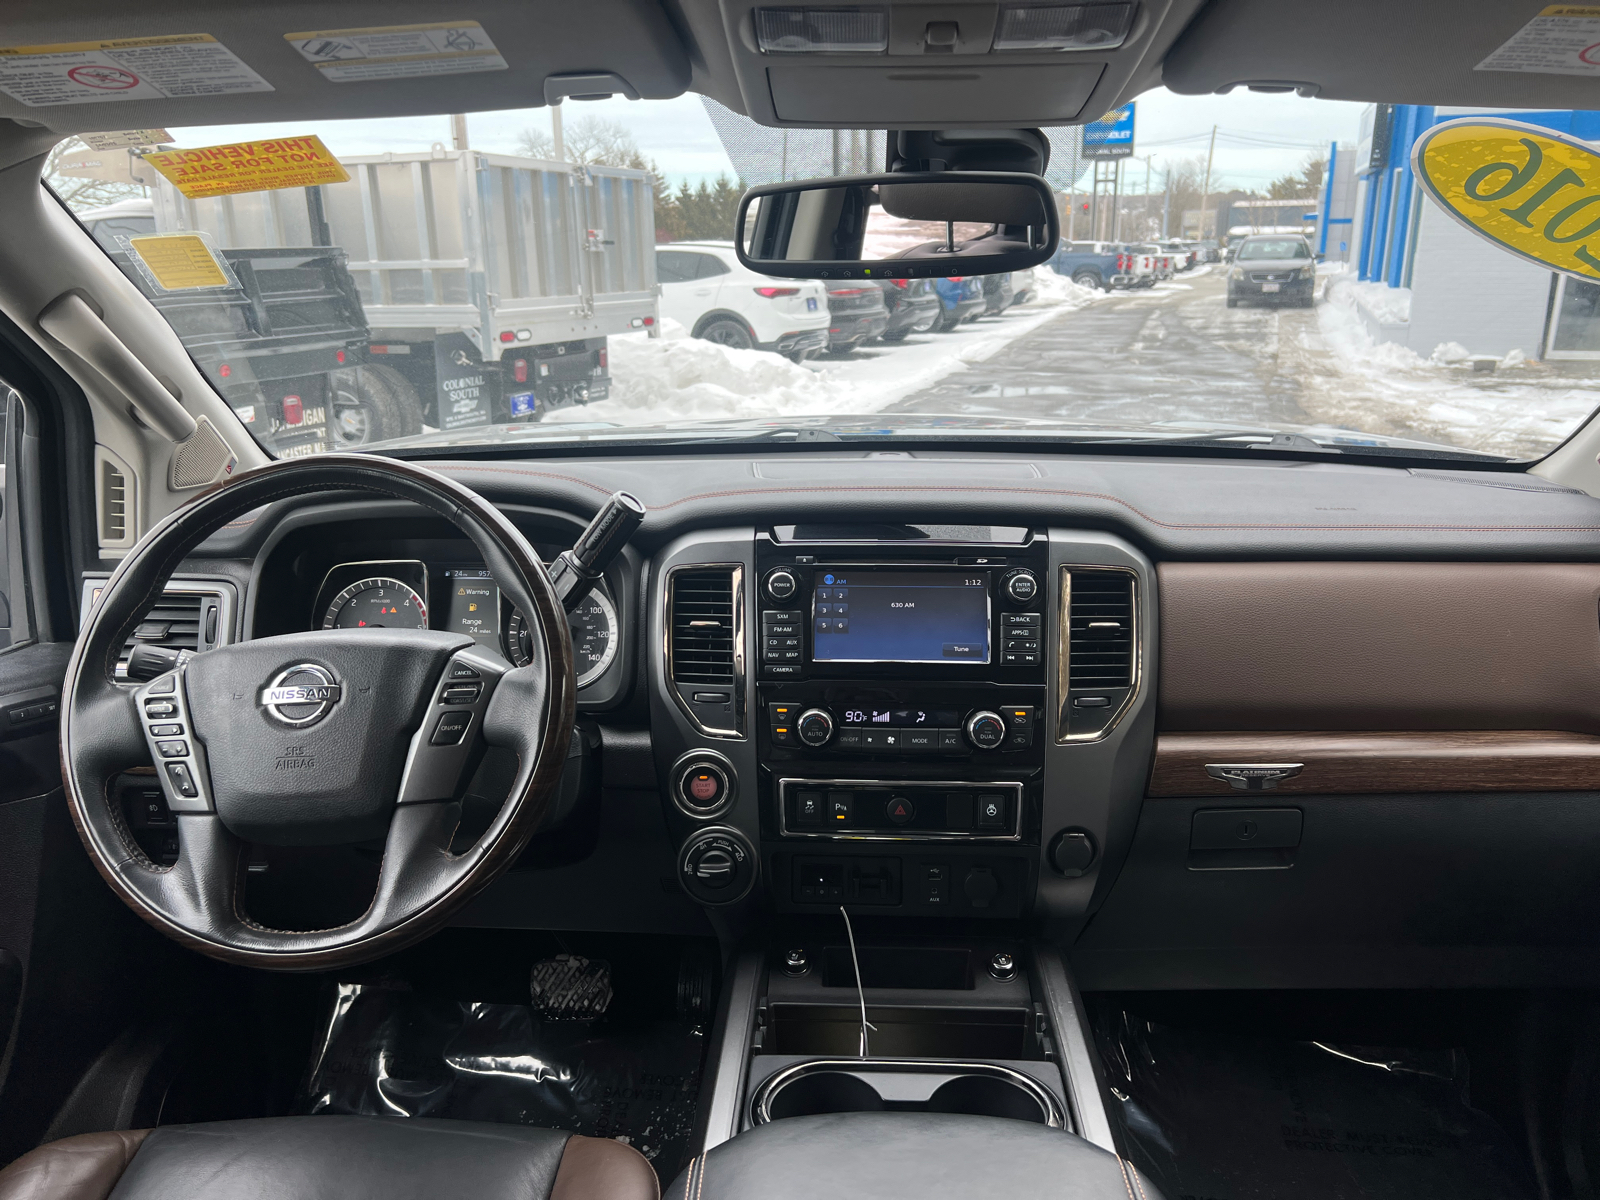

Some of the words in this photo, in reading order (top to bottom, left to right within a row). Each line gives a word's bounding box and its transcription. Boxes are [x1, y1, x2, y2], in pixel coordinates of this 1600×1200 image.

[443, 375, 485, 391] COLONIAL
[450, 387, 479, 401] SOUTH
[592, 527, 603, 543] TOW
[600, 514, 615, 532] MODE
[466, 588, 490, 596] Warning
[462, 618, 482, 626] Range
[270, 688, 330, 700] NISSAN
[286, 747, 304, 756] SRS
[275, 759, 315, 770] AIRBAG
